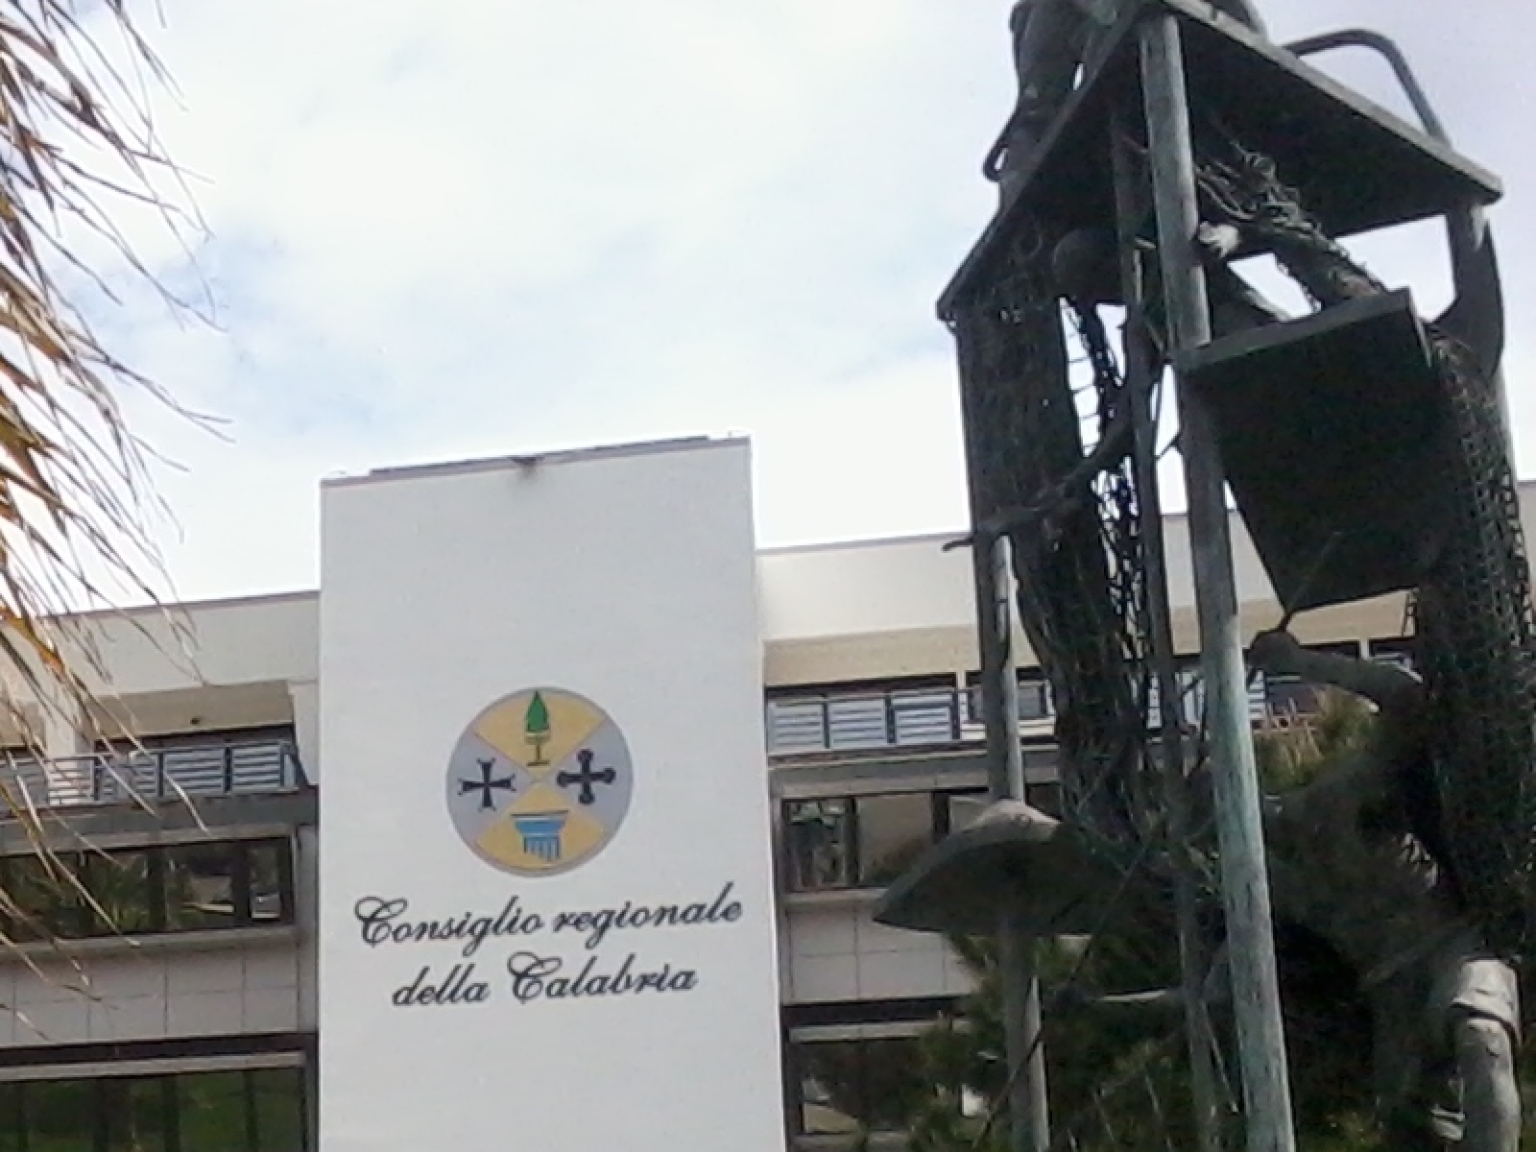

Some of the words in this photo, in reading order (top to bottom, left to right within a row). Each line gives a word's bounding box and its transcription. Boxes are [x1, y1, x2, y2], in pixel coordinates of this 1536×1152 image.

[354, 896, 544, 957] Consiglio
[552, 882, 743, 950] regionale
[392, 963, 490, 1006] della
[507, 951, 698, 1004] Calabria
